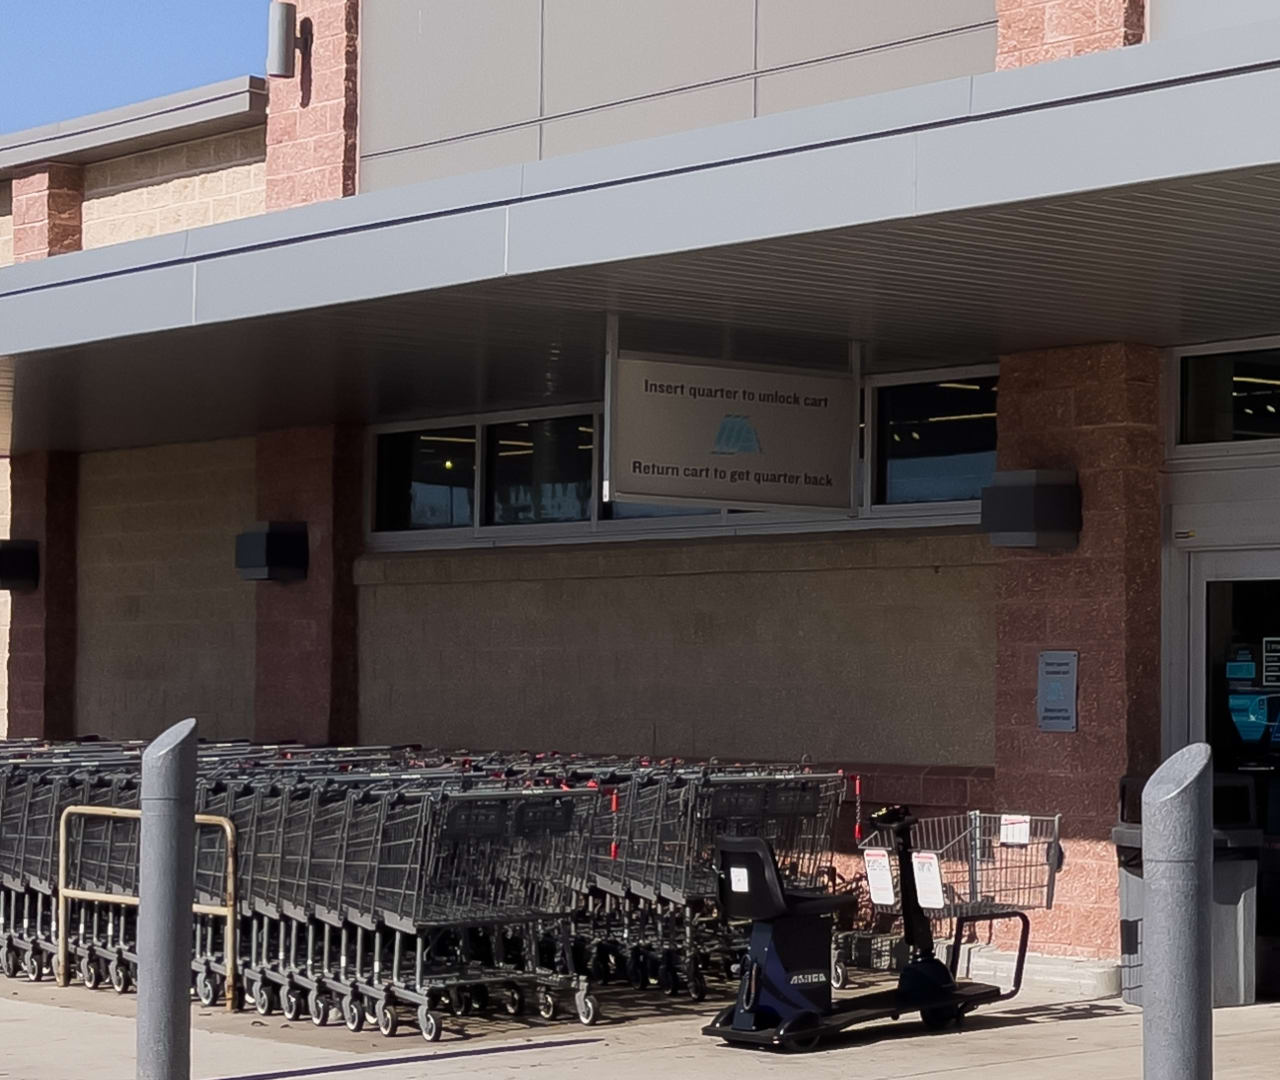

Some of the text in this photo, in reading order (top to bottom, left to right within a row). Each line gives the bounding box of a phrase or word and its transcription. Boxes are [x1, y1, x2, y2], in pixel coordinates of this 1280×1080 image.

[644, 379, 829, 408] Insert quarter to unlock cart
[632, 460, 833, 487] Return cart to get quarter back
